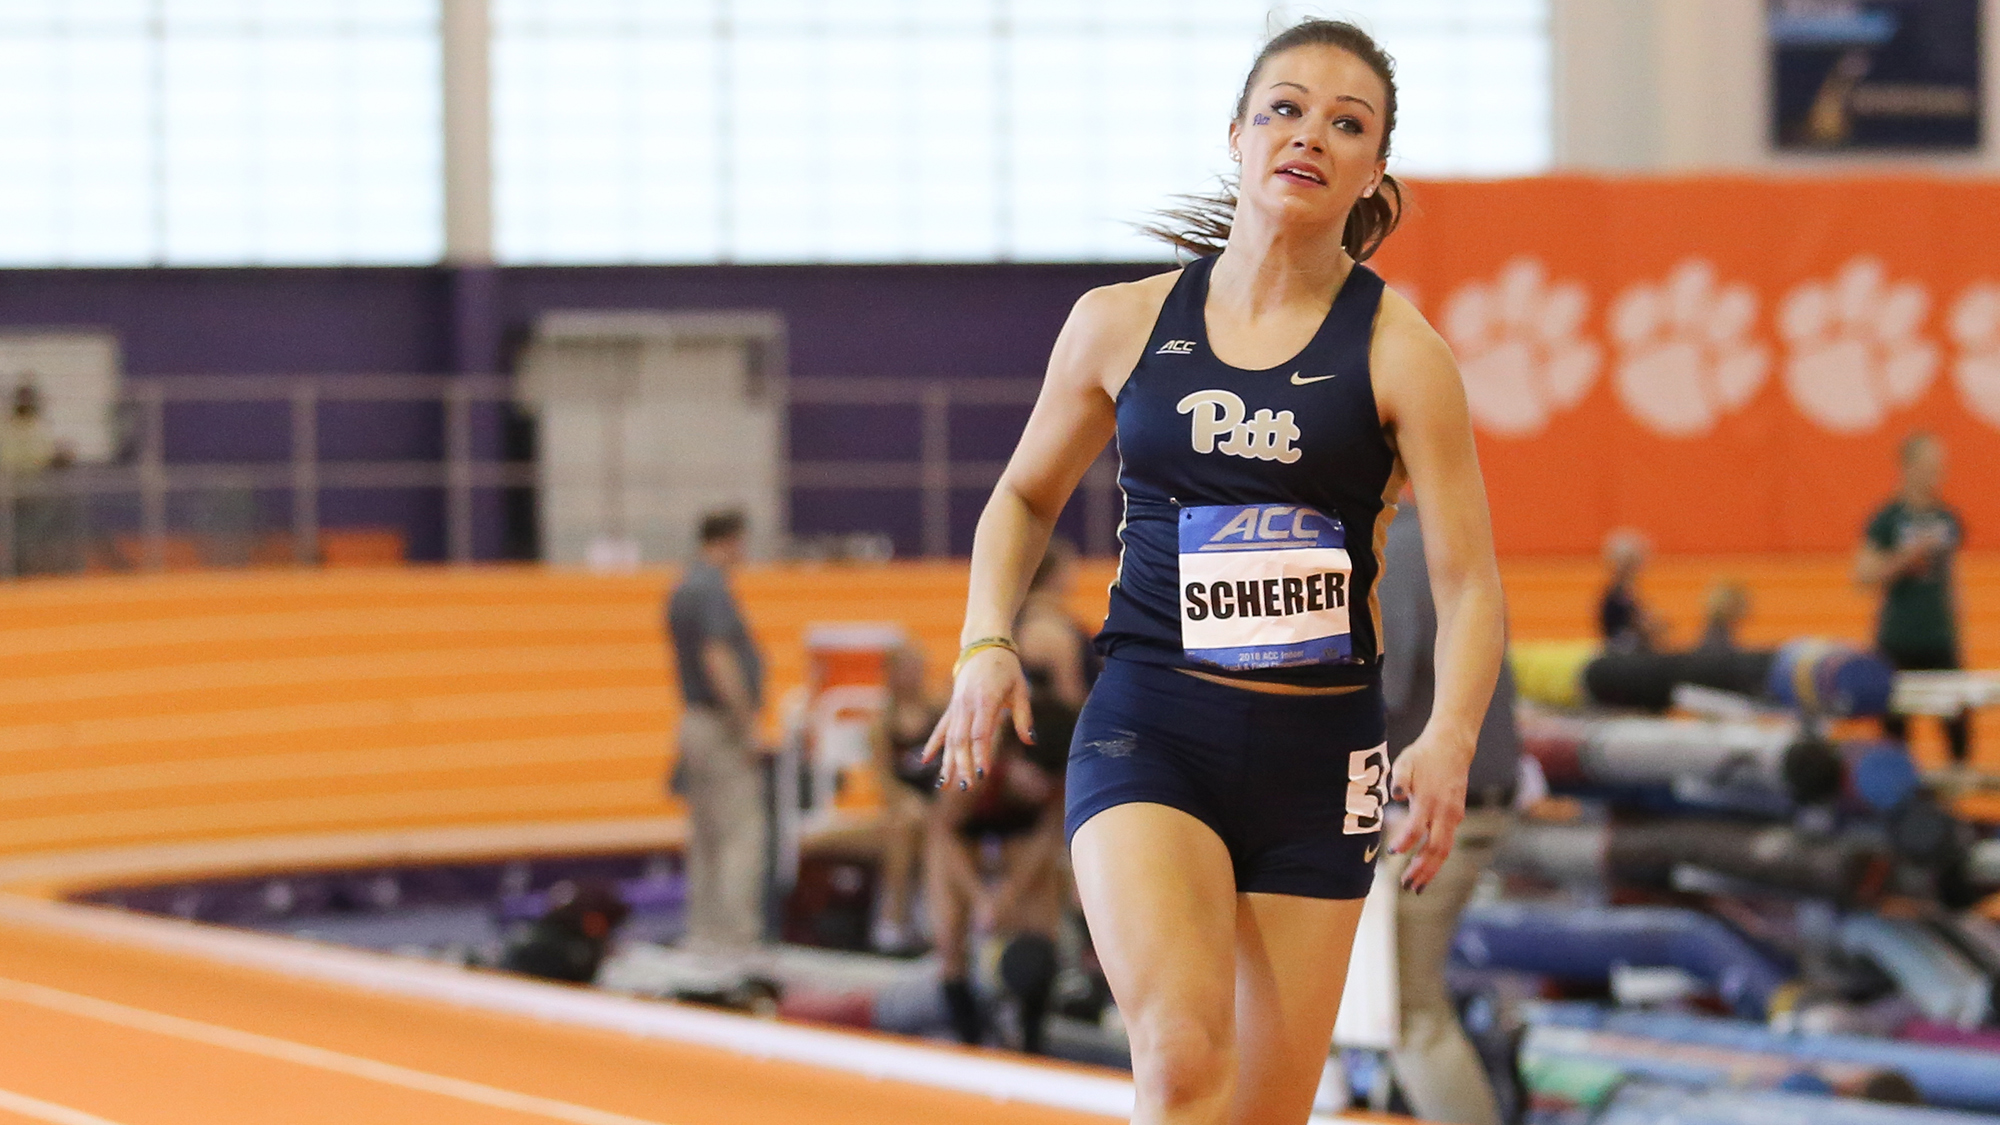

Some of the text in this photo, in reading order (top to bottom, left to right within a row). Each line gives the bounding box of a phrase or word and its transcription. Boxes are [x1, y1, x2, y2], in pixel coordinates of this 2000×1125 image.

[1158, 340, 1197, 352] ACC
[1176, 389, 1302, 464] Pitt
[1210, 506, 1324, 541] ACC
[1185, 572, 1346, 621] SCHERER
[1263, 651, 1279, 660] ACC
